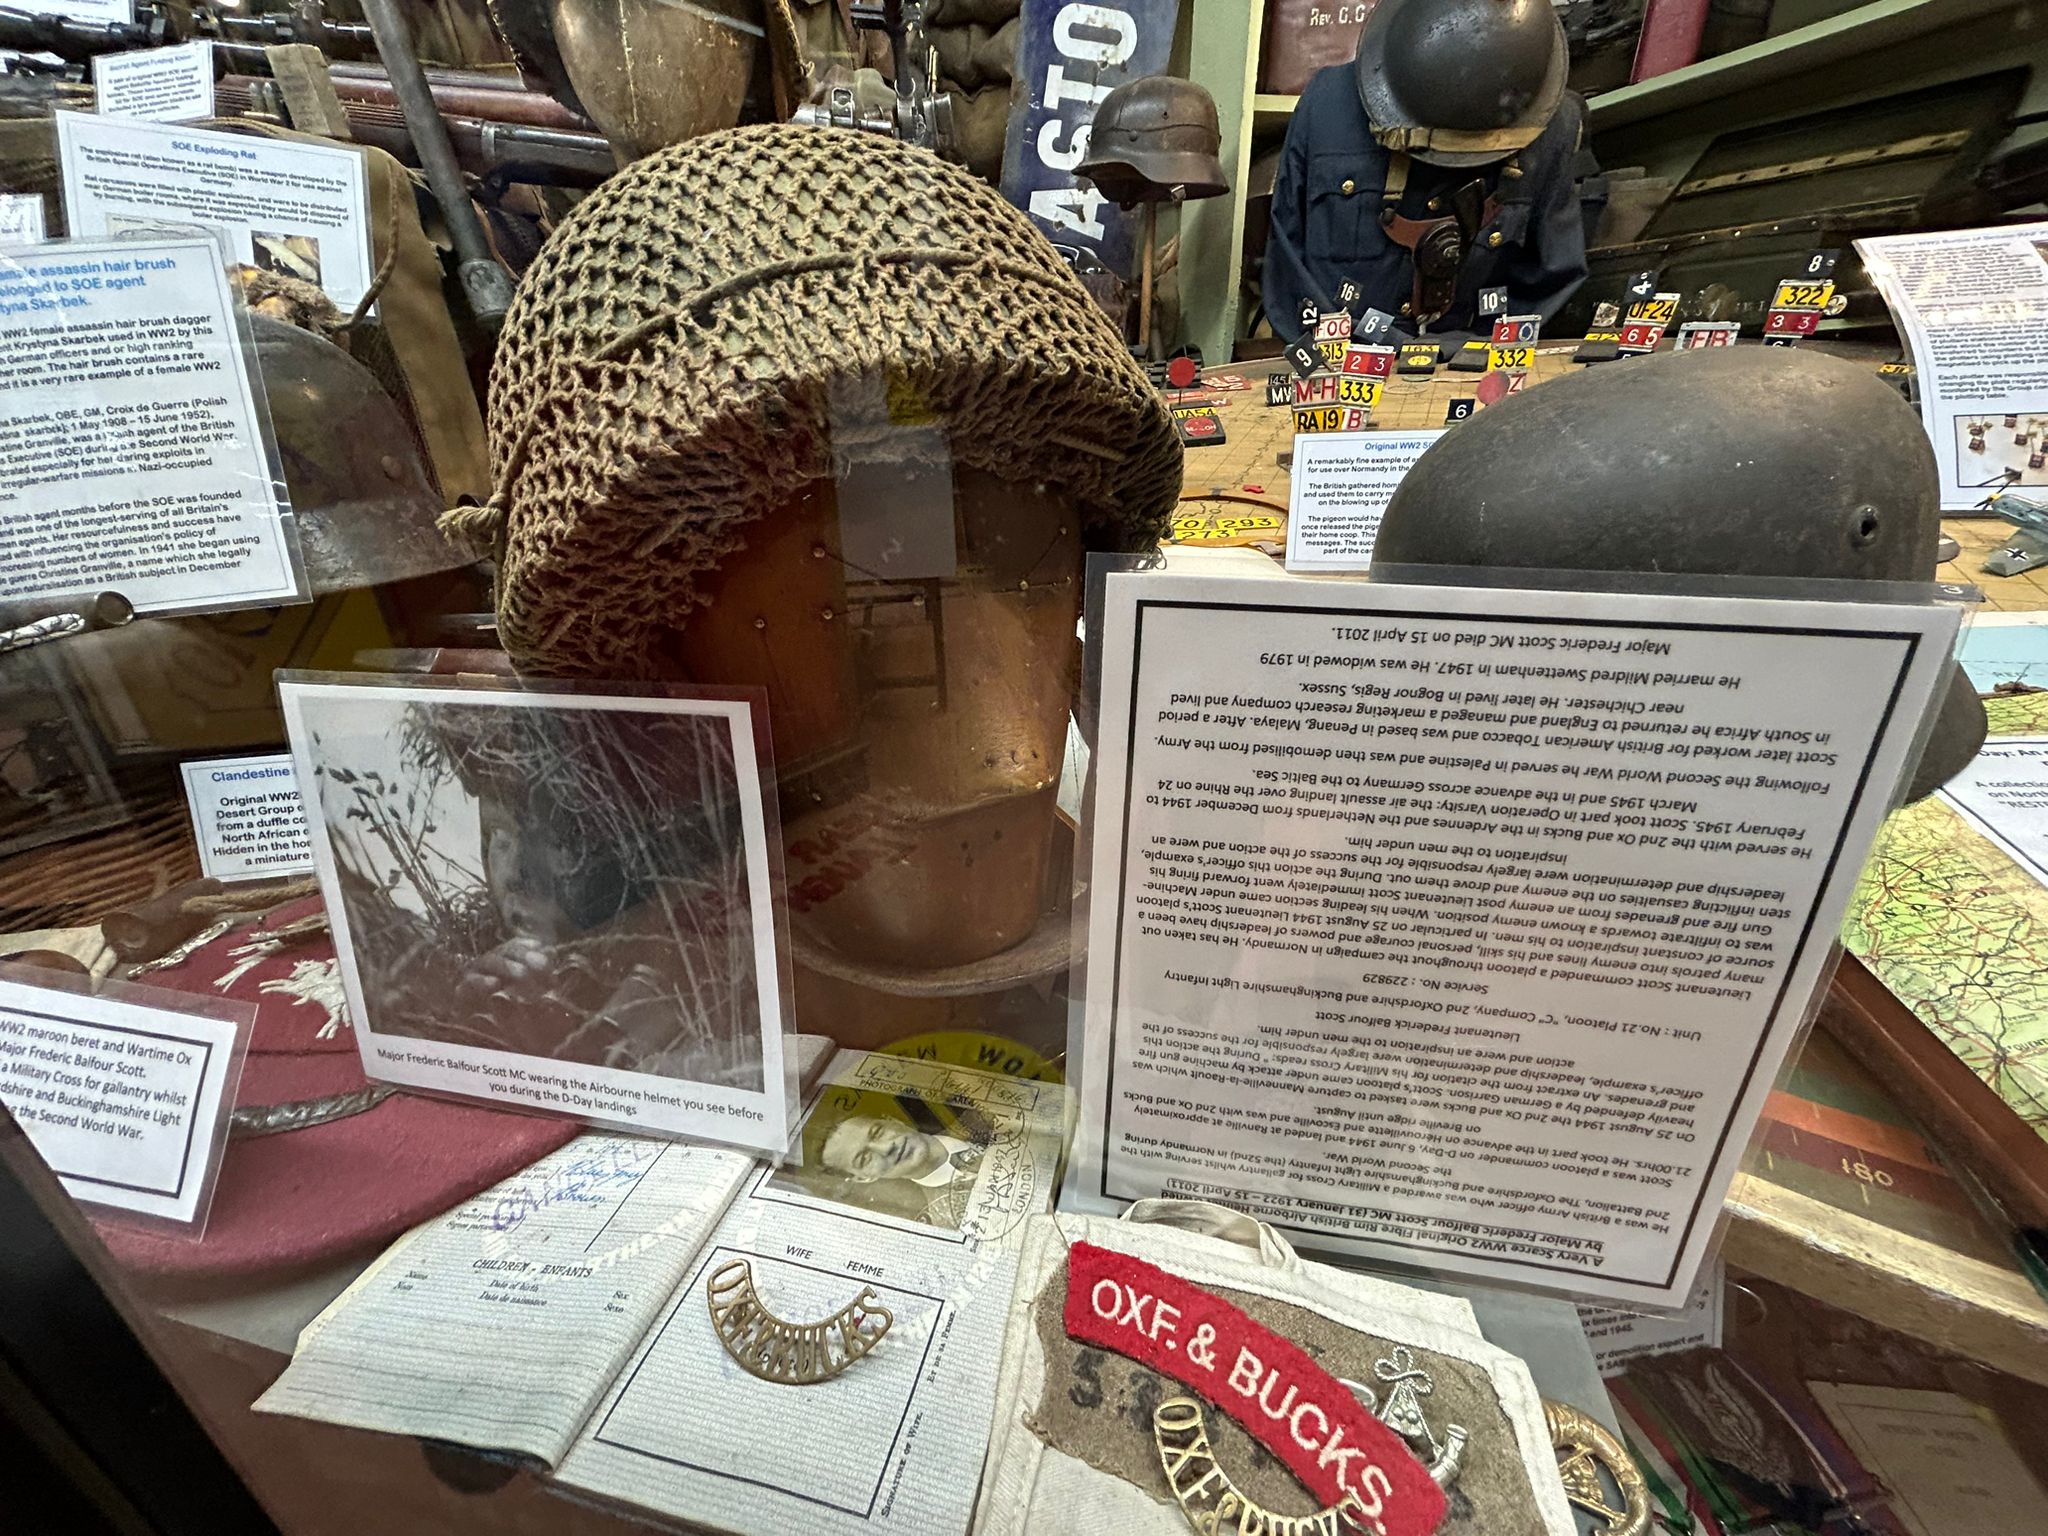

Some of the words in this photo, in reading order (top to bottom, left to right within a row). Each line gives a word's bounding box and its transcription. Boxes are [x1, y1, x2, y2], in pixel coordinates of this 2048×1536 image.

[171, 140, 192, 151] SOE
[193, 143, 239, 159] Exploding
[240, 149, 256, 160] Rat
[39, 260, 101, 277] assassin
[102, 259, 131, 272] hair
[133, 257, 176, 270] brush
[1808, 255, 1823, 272] 8
[53, 280, 69, 292] to
[70, 276, 103, 293] SOE
[104, 274, 146, 290] agent
[1632, 281, 1651, 295] 4
[1340, 282, 1355, 302] 16
[1785, 287, 1823, 306] 322
[1482, 292, 1498, 311] 10
[1302, 306, 1318, 326] 12
[1364, 316, 1380, 333] 6
[1296, 348, 1313, 367] 9
[1324, 342, 1344, 360] 313
[1494, 349, 1527, 367] 332
[1340, 381, 1374, 403] 333
[1455, 404, 1467, 418] 6
[1364, 441, 1397, 451] Original
[1399, 441, 1421, 449] WW2
[1314, 457, 1354, 465] remarkably
[1370, 456, 1401, 464] example
[1402, 455, 1410, 463] of
[97, 501, 131, 512] before
[132, 499, 150, 508] the
[151, 495, 175, 506] SOE
[175, 495, 198, 504] was
[198, 489, 242, 501] founded
[1222, 518, 1272, 528] 293
[1181, 530, 1229, 539] 273
[1331, 627, 1370, 641] 2011.
[1372, 627, 1408, 642] April
[1410, 630, 1428, 644] 15
[1432, 631, 1451, 642] on
[1453, 632, 1486, 647] died
[1489, 634, 1514, 648] MC
[1517, 635, 1556, 650] Scott
[1558, 637, 1621, 653] Frederic
[1624, 638, 1671, 655] Major
[1259, 652, 1293, 666] 1979
[1297, 654, 1310, 667] in
[1312, 655, 1376, 670] widowed
[1379, 658, 1407, 669] was
[1410, 660, 1430, 672] He
[1434, 661, 1473, 675] 1947.
[1477, 664, 1491, 676] in
[1494, 664, 1587, 681] Swettenham
[1589, 670, 1650, 684] Mildred
[1652, 672, 1715, 686] married
[1718, 675, 1740, 689] He
[210, 767, 290, 782] Clandestine
[219, 793, 267, 806] Original
[268, 790, 300, 802] WW2
[215, 806, 256, 819] Desert
[257, 805, 294, 815] Group
[216, 822, 244, 831] from
[256, 816, 289, 827] duffle
[221, 831, 255, 843] North
[257, 828, 300, 840] African
[211, 844, 254, 856] Hidden
[256, 842, 268, 852] in
[270, 841, 290, 851] the
[254, 852, 310, 864] miniature
[26, 1027, 68, 1044] maroon
[70, 1032, 100, 1049] beret
[101, 1040, 125, 1053] and
[126, 1042, 174, 1062] Wartime
[175, 1050, 192, 1065] Ox
[28, 1044, 72, 1065] Frederic
[73, 1053, 115, 1072] Balfour
[114, 1060, 146, 1078] Scott.
[2, 1063, 8, 1072] a
[9, 1061, 51, 1083] Military
[52, 1070, 82, 1087] Cross
[83, 1074, 101, 1090] for
[101, 1080, 152, 1102] gallantry
[153, 1089, 187, 1106] whilst
[376, 1048, 404, 1061] Major
[406, 1052, 445, 1067] Frederic
[445, 1058, 480, 1072] Balfour
[481, 1063, 507, 1077] Scott
[508, 1068, 526, 1080] MC
[527, 1073, 568, 1090] wearing
[569, 1078, 587, 1091] the
[588, 1081, 641, 1100] Airbourne
[642, 1090, 681, 1107] helmet
[682, 1099, 704, 1110] you
[705, 1103, 725, 1114] see
[727, 1104, 763, 1121] before
[488, 1082, 507, 1092] you
[509, 1084, 541, 1100] during
[542, 1089, 560, 1102] the
[561, 1092, 592, 1109] D-Day
[593, 1097, 637, 1116] landings
[18, 1104, 37, 1119] the
[38, 1108, 79, 1127] Second
[80, 1116, 115, 1134] World
[117, 1123, 144, 1140] War.
[787, 1245, 813, 1260] WIFE
[472, 1259, 530, 1272] CHILDREN
[540, 1263, 593, 1278] ENFANTS
[846, 1260, 884, 1278] FEMME
[1186, 1322, 1218, 1371] &
